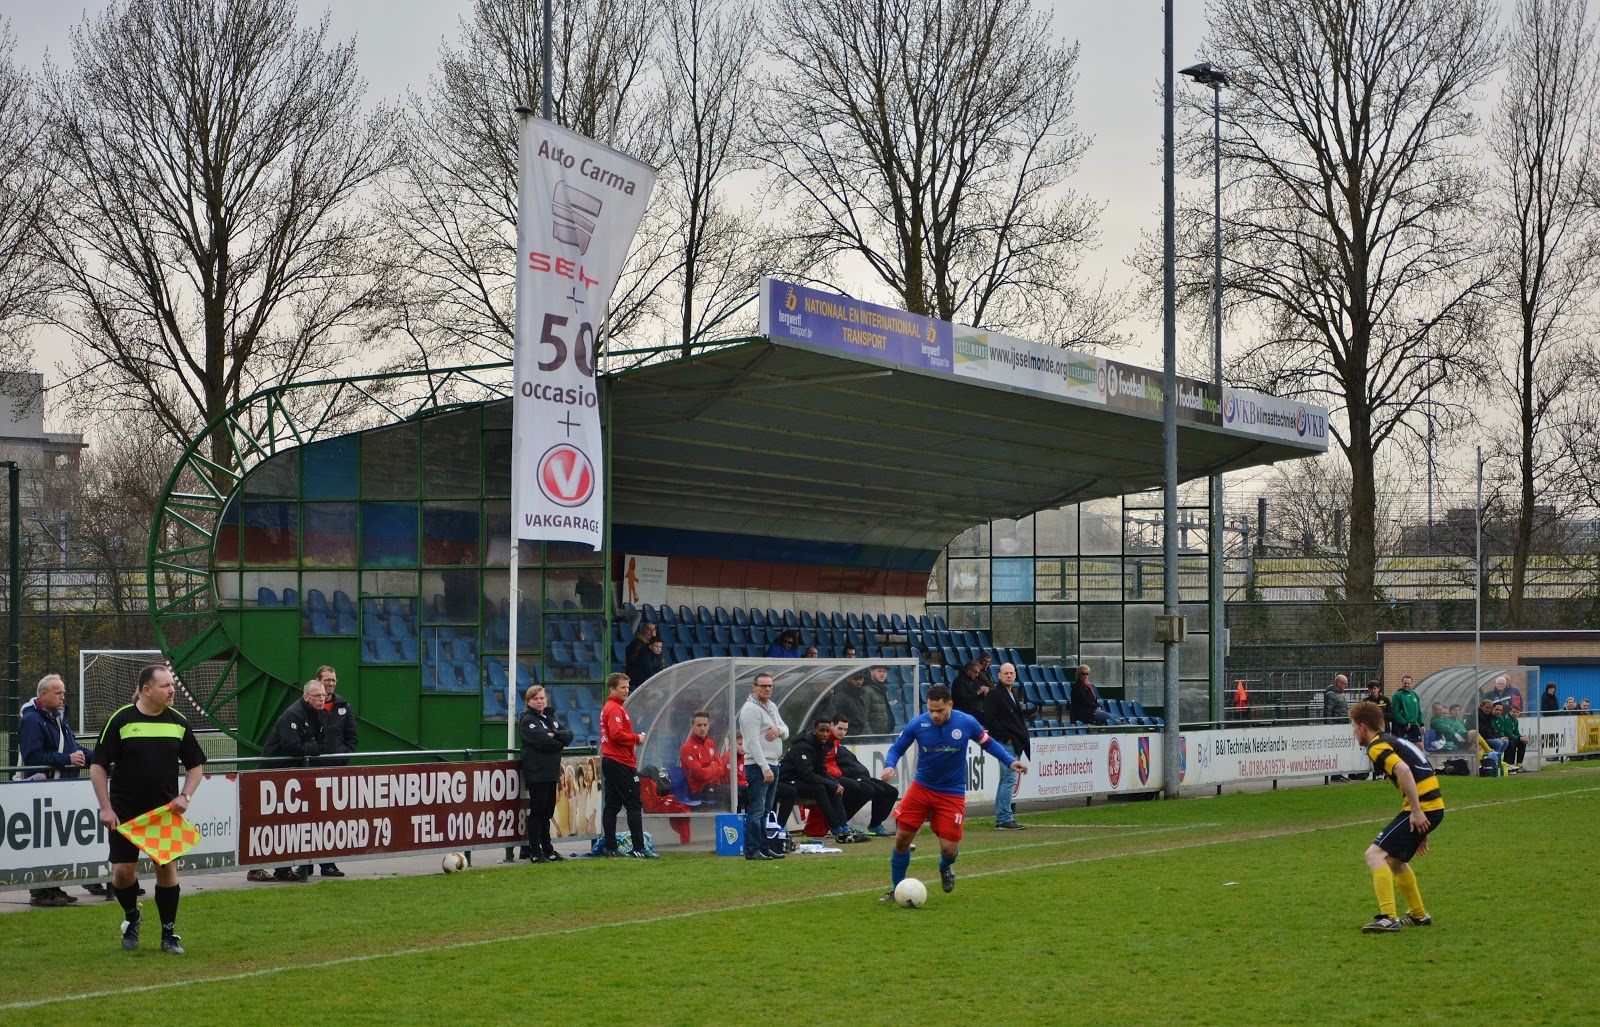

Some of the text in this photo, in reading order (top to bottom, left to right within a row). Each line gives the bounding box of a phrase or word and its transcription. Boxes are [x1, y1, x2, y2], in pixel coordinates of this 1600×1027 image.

[538, 140, 636, 195] Auto Carma
[805, 297, 921, 338] NATIONAAL EN INTERNATIONAAL
[538, 313, 595, 378] 50
[842, 327, 887, 351] TRANSPORT
[989, 346, 1068, 381] www.ijsselmonde.org
[1118, 370, 1164, 410] footballshop.
[1235, 398, 1325, 438] VKB klimaattechniek VKB
[525, 513, 599, 534] VAKGARAGE
[1057, 740, 1068, 752] week
[1215, 739, 1226, 755] B&I
[1226, 737, 1252, 754] Techniek
[1252, 735, 1280, 753] Nederland
[1280, 735, 1288, 751] bv
[1323, 734, 1356, 751] Installatiebedrij
[1039, 757, 1093, 777] Lust Barendrecht
[1290, 754, 1338, 773] www.bitechniek.nl
[260, 778, 309, 815] D.C.
[315, 771, 467, 812] TUINENBURG
[1038, 784, 1061, 796] Reserveren
[0, 797, 104, 851] eliver
[249, 819, 370, 857] KOUWENOORD
[373, 817, 392, 847] 79
[411, 814, 444, 843] TEL.
[447, 812, 474, 841] 010
[476, 810, 495, 839] 48
[497, 809, 515, 838] 22
